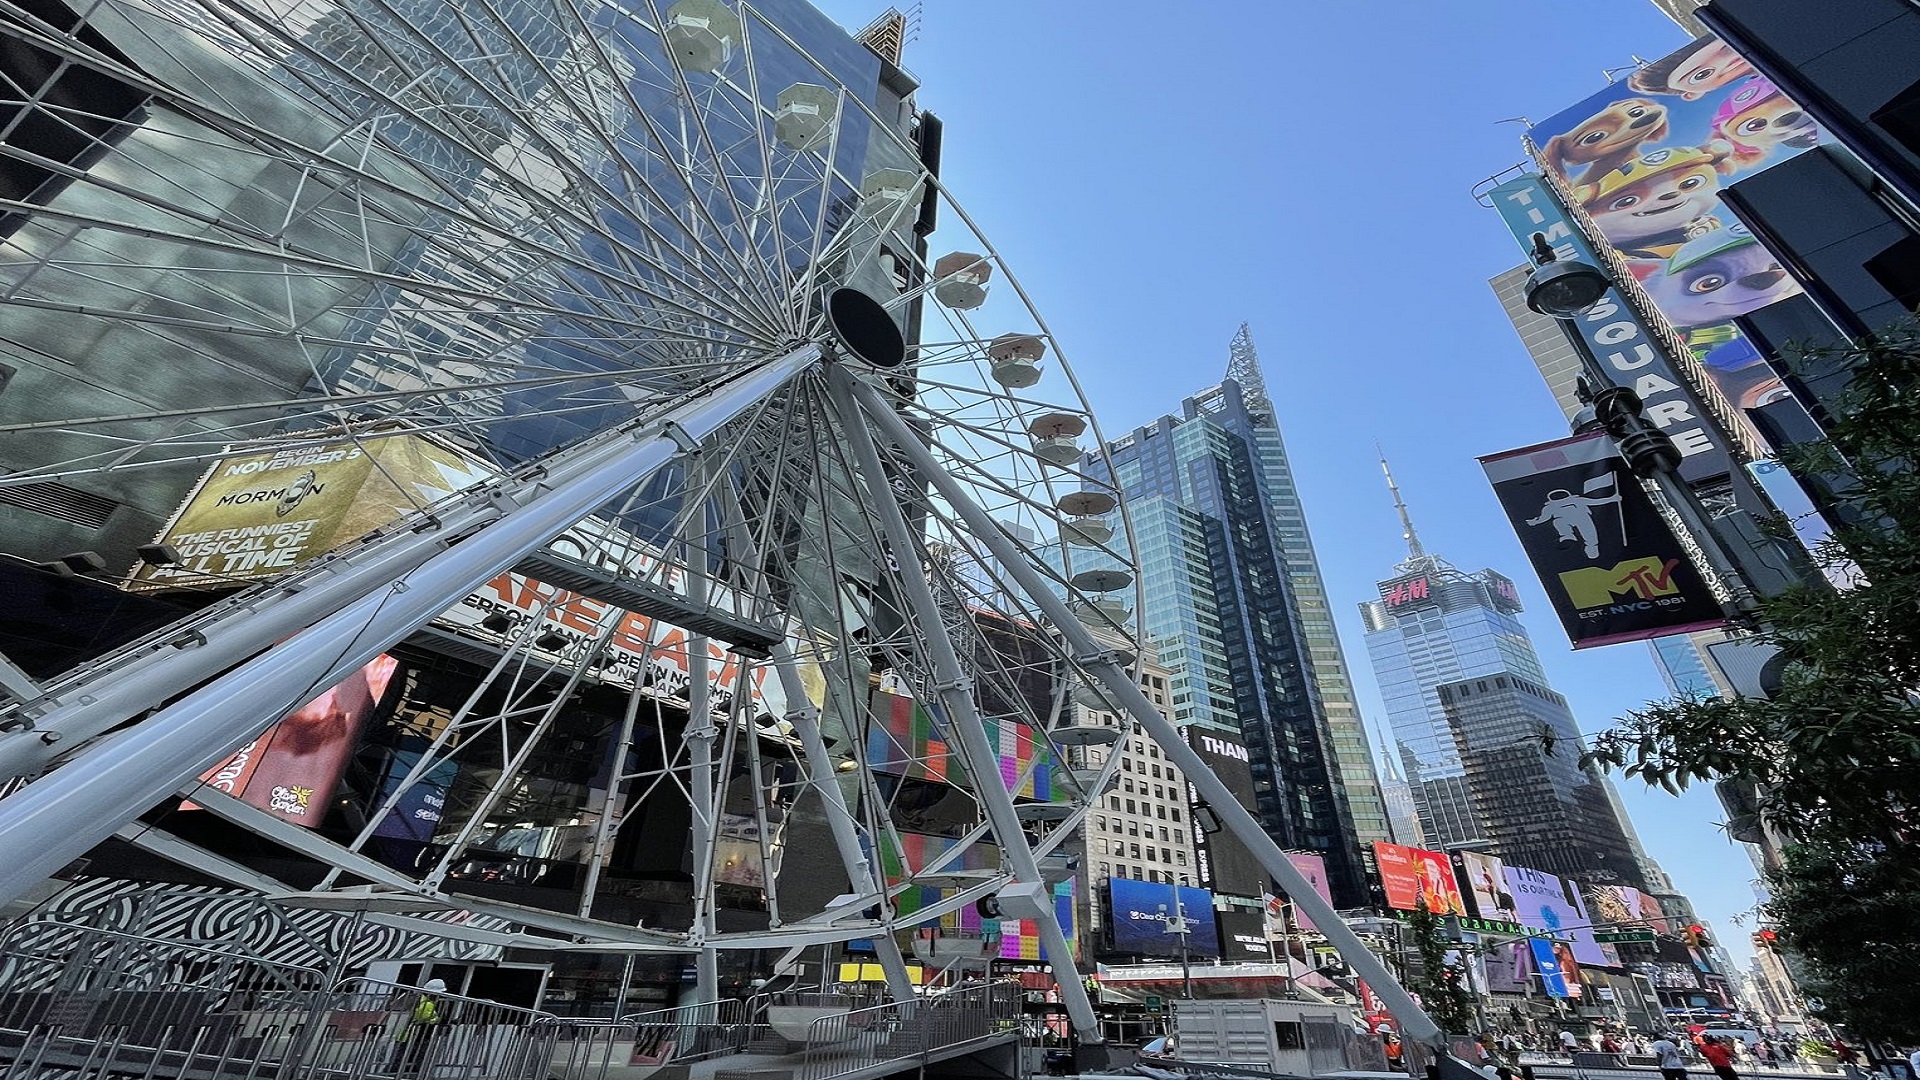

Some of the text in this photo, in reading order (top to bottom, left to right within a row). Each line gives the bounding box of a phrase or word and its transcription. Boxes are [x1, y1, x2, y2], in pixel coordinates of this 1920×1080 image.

[1586, 297, 1716, 458] SQUARE
[223, 449, 347, 477] NOVEMBER
[272, 445, 326, 460] BEGIN
[215, 519, 320, 541] FUNNIEST
[272, 531, 312, 548] OF
[1558, 556, 1680, 610] MTV
[1579, 596, 1687, 619] EST. NYC 1981
[272, 786, 297, 801] Olive
[271, 797, 306, 815] Garden
